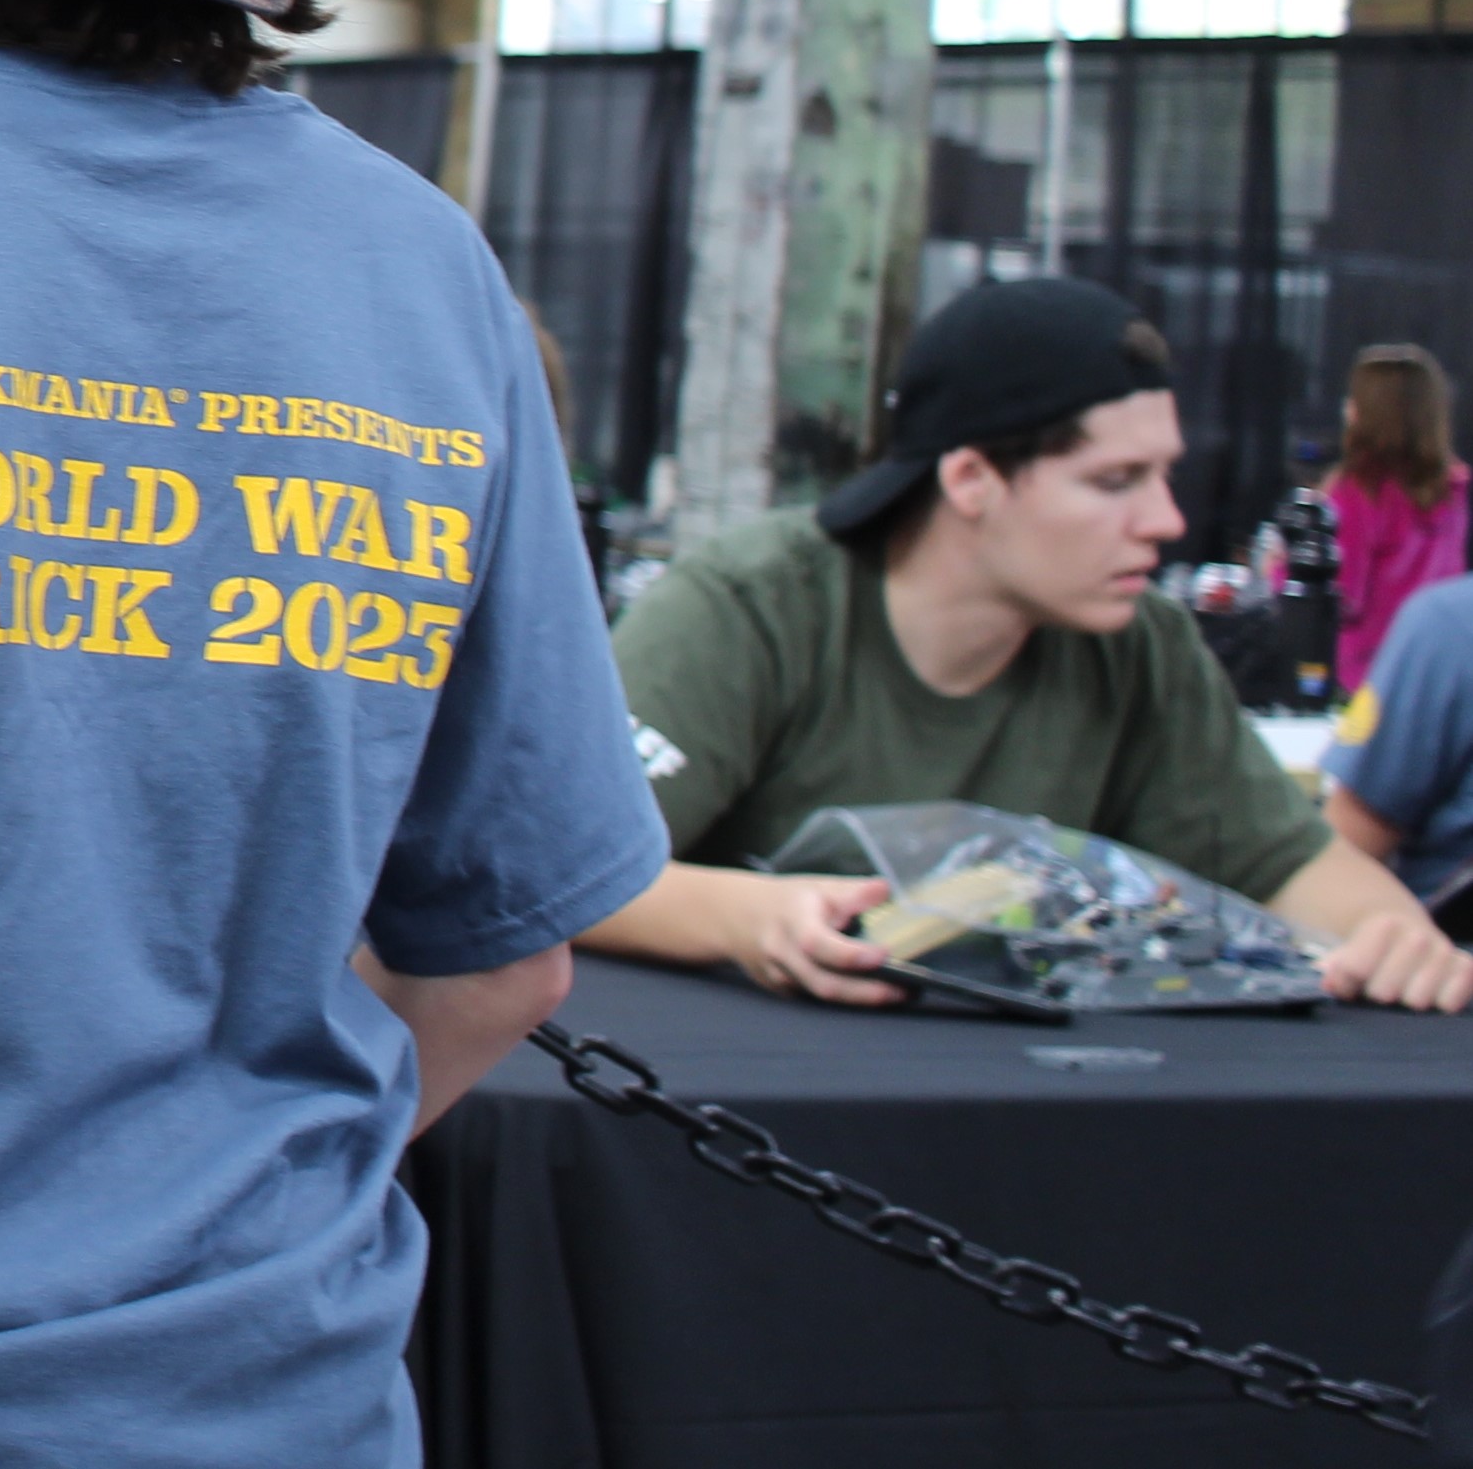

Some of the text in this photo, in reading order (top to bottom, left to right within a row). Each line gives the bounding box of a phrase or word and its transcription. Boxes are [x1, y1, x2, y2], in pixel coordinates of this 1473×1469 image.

[197, 390, 486, 469] PRESENTS
[233, 475, 473, 585] WAR
[203, 576, 463, 691] 2023
